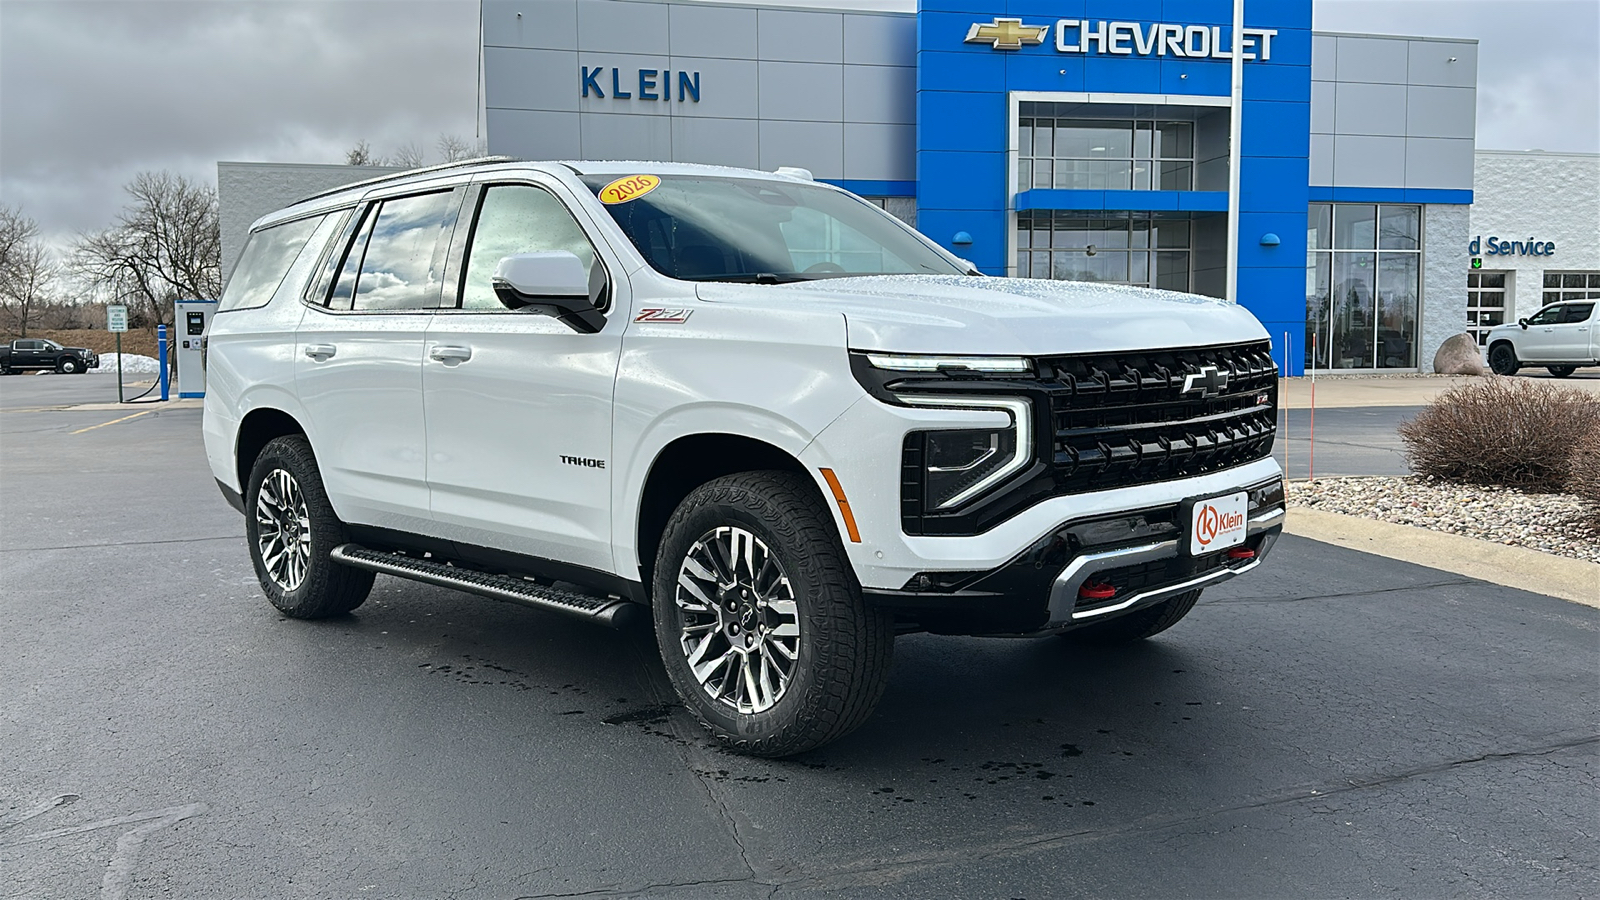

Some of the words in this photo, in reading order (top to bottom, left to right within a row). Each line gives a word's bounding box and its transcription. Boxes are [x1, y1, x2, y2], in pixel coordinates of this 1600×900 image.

[1055, 19, 1278, 61] CHEVROLET
[581, 66, 700, 103] KLEIN
[608, 176, 652, 201] 2026
[1486, 236, 1556, 256] Service
[559, 454, 606, 469] TAHOE
[1218, 510, 1243, 531] Klein
